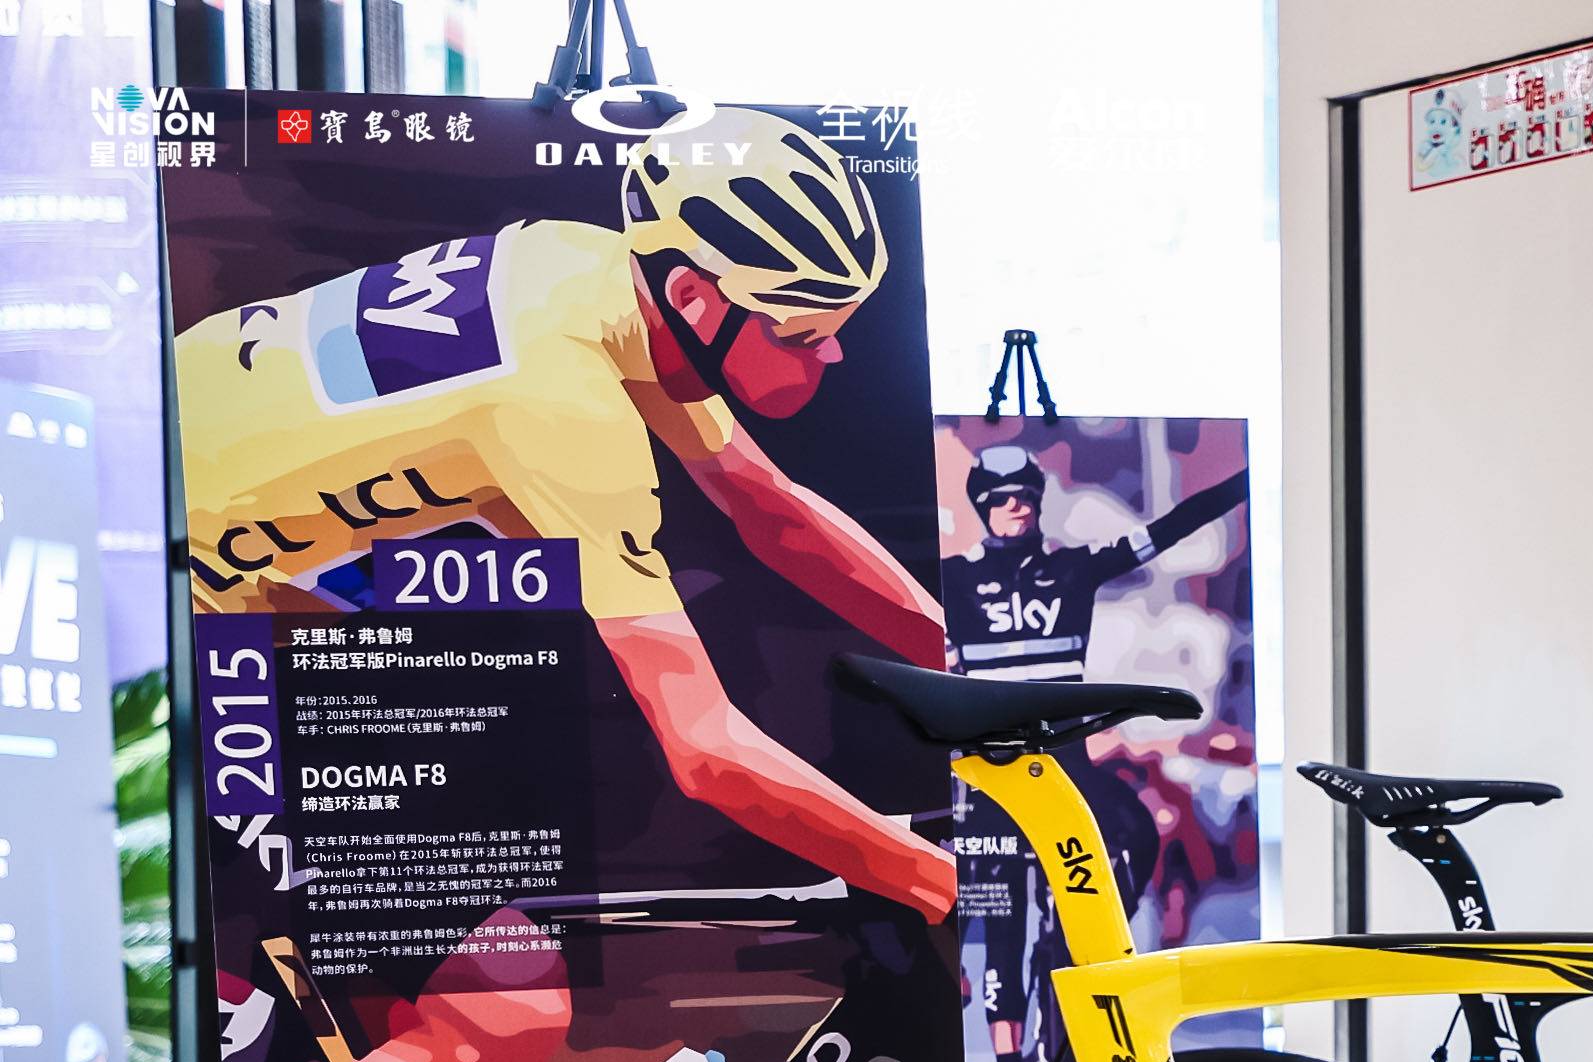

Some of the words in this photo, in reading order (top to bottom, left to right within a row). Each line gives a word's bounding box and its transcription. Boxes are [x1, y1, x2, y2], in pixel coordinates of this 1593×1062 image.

[393, 548, 549, 605] 2016
[471, 652, 534, 670] Dogma
[537, 650, 559, 666] F8
[208, 647, 276, 799] 2015
[301, 765, 408, 789] DOGMA
[414, 763, 447, 786] F8
[301, 795, 400, 813] 缔造环法赢家
